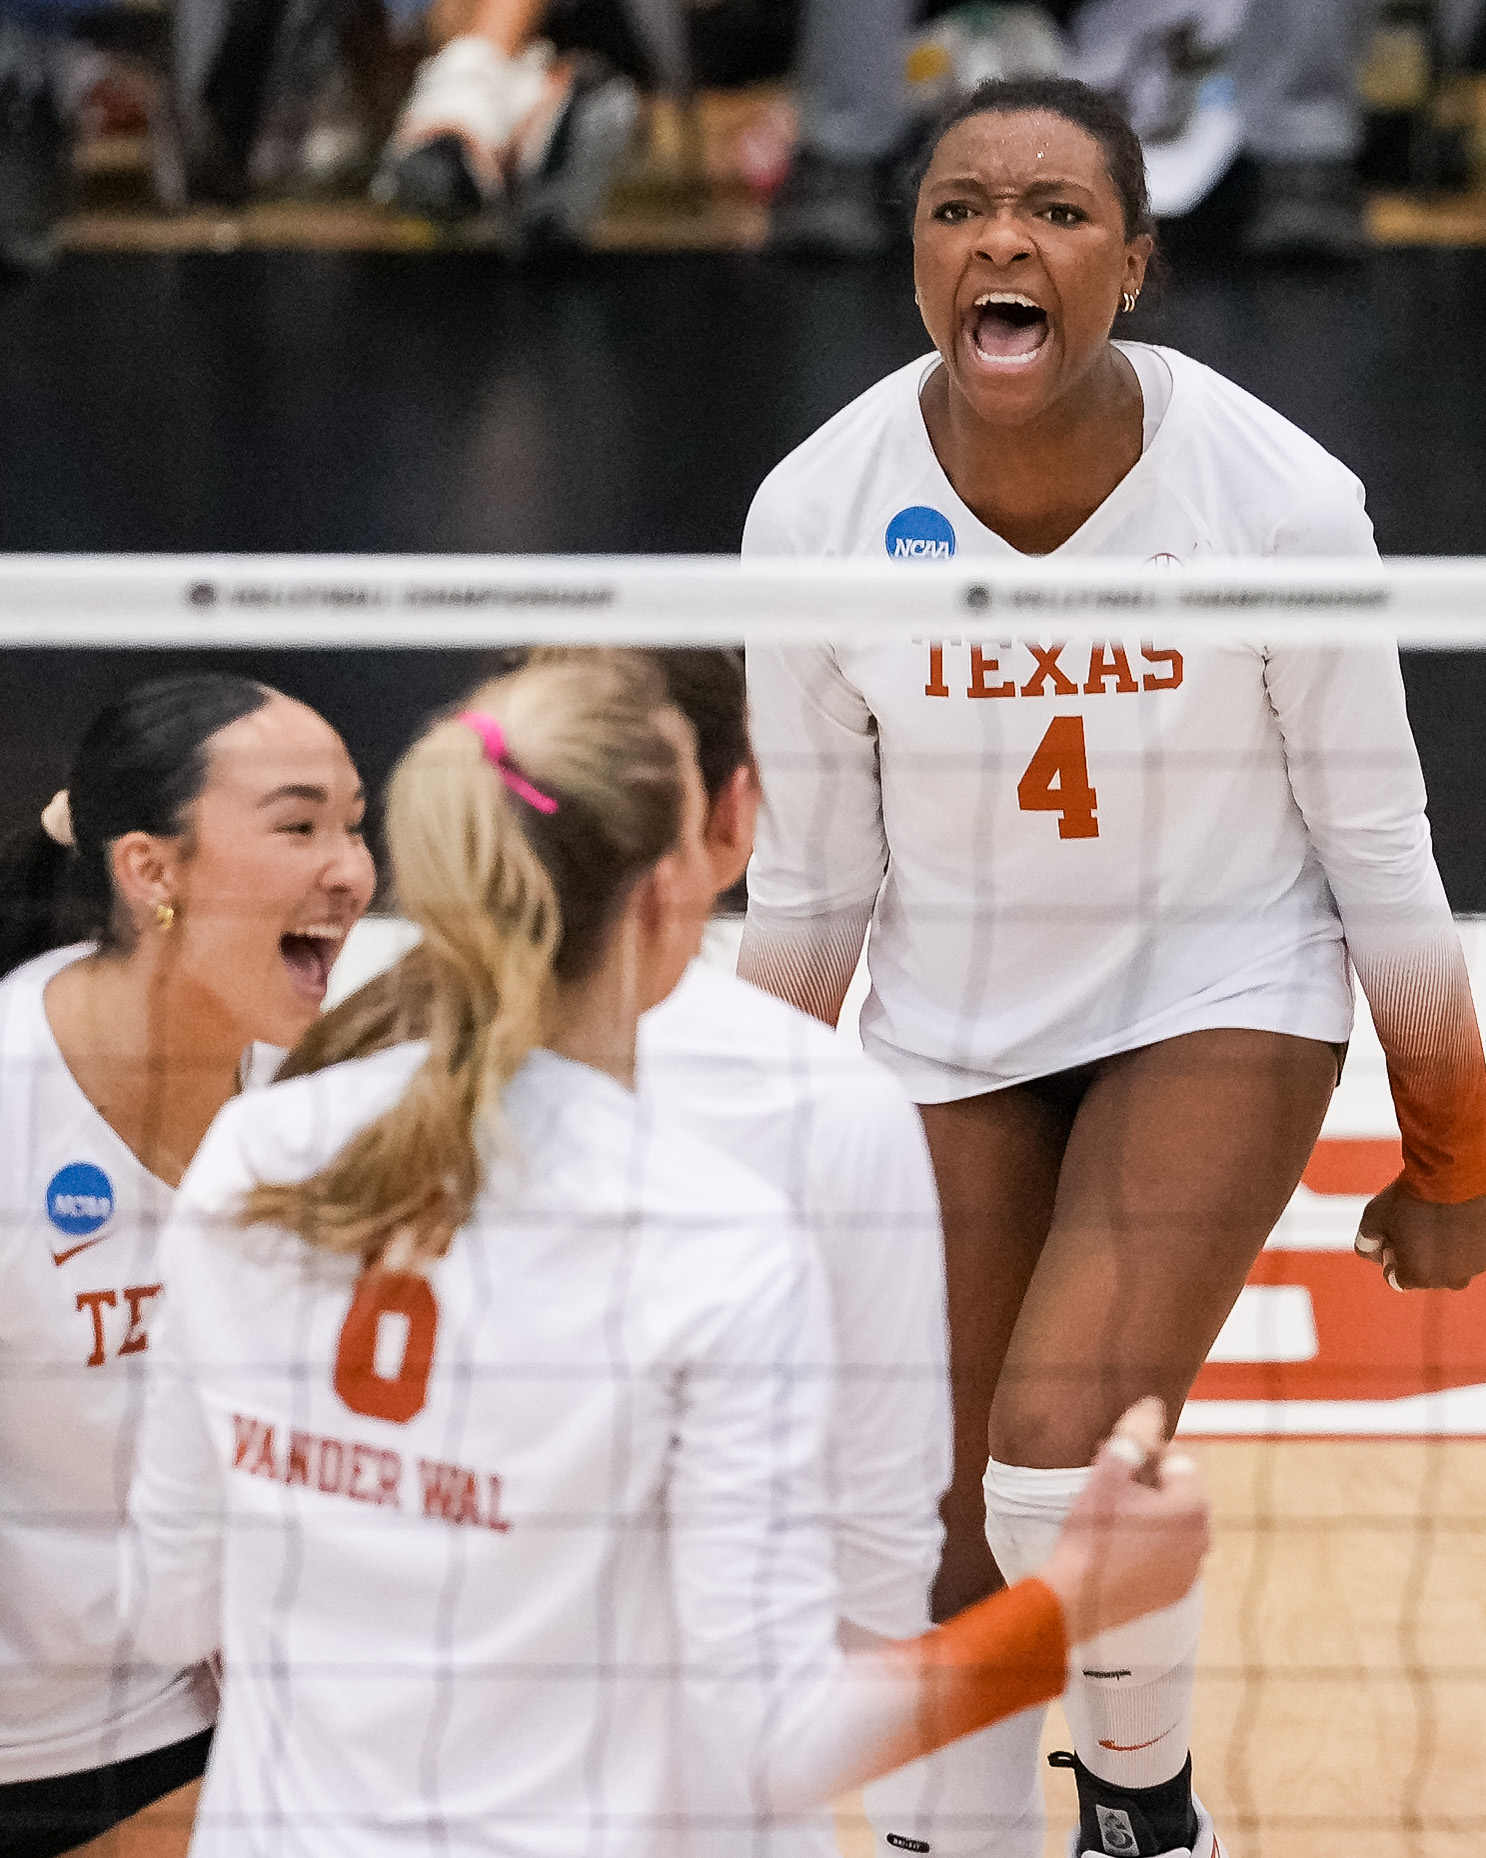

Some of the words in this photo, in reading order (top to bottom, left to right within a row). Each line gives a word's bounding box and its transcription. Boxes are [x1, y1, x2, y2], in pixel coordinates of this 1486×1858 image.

[894, 537, 950, 559] NCAA
[918, 637, 1184, 699] TEXAS
[1016, 714, 1100, 840] 4
[332, 1270, 439, 1425] 0
